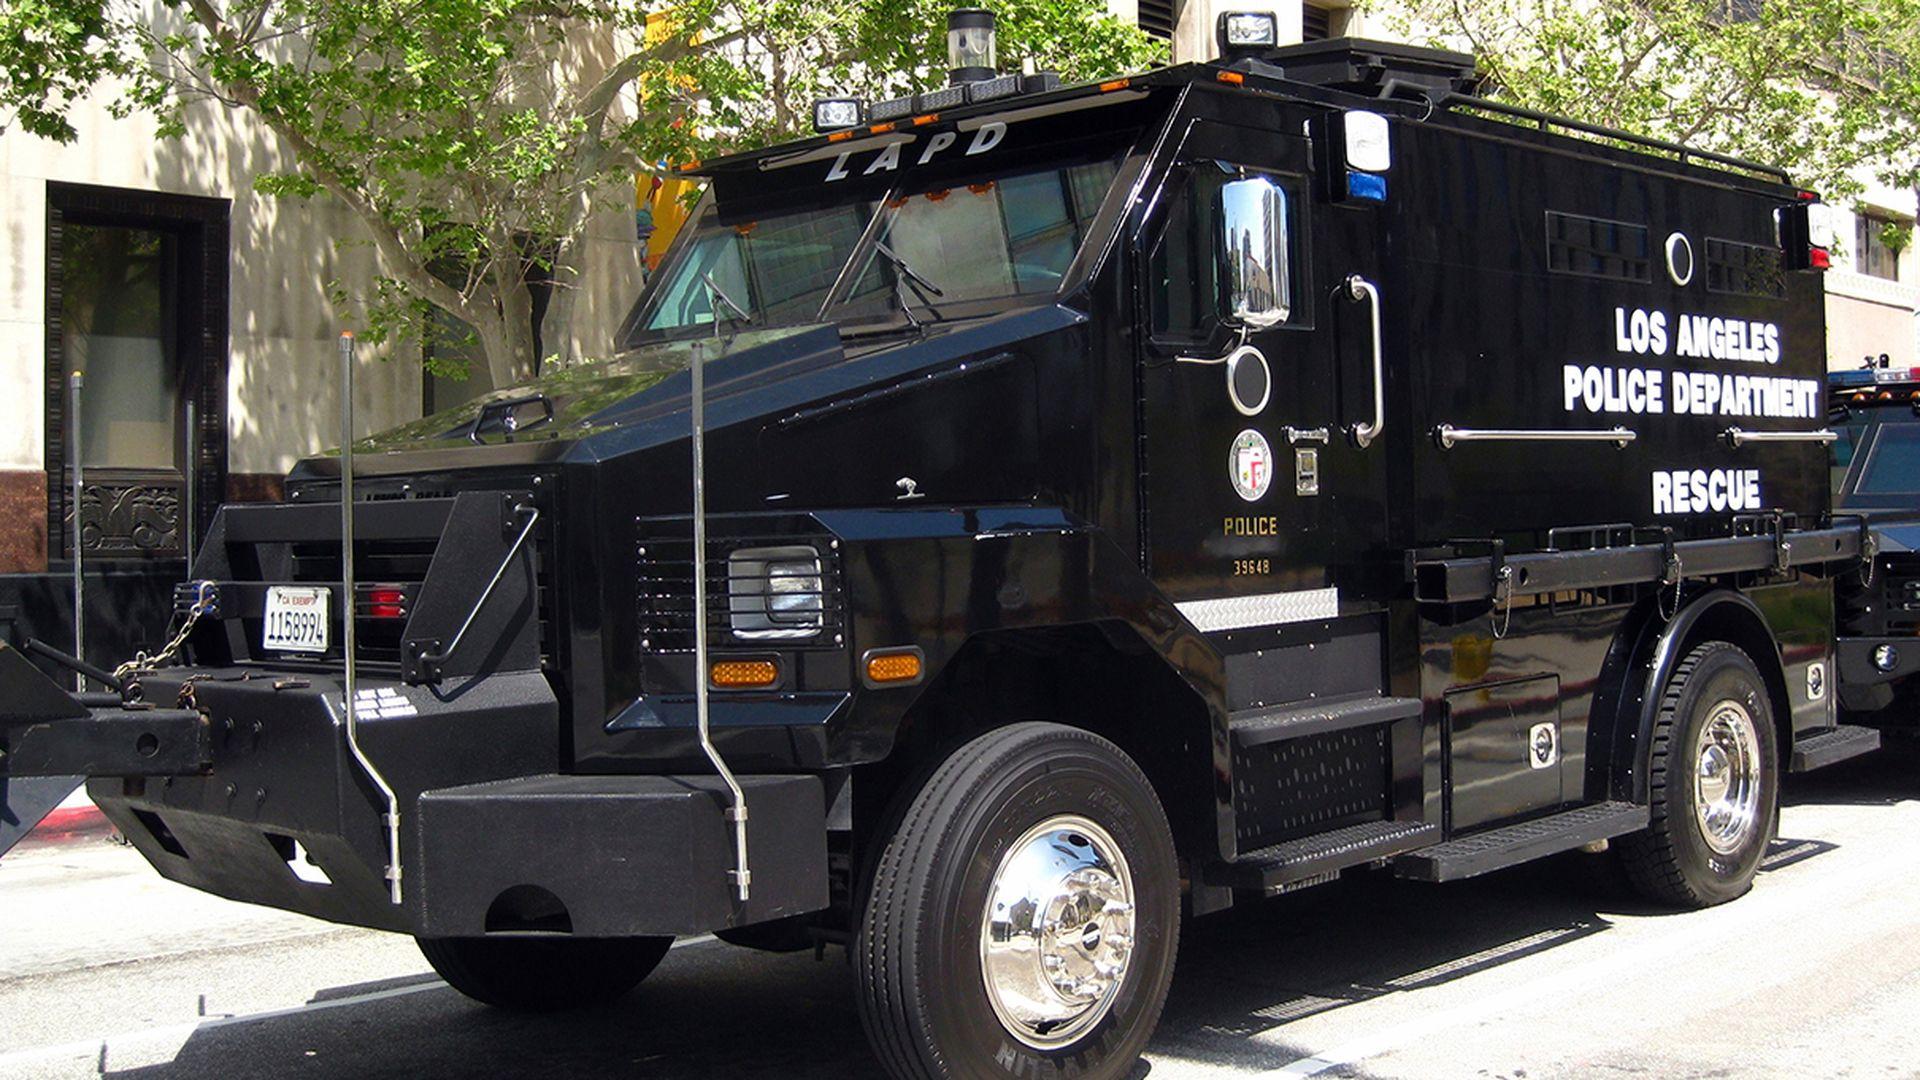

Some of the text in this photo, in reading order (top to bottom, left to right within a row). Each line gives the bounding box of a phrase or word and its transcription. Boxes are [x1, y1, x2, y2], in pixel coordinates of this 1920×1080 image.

[825, 122, 1008, 182] LAPD
[1614, 307, 1780, 364] LOS ANGELES
[1563, 365, 1819, 418] POLICE DEPARTMENT
[1652, 469, 1761, 514] RESCUE
[1224, 517, 1277, 536] POLICE
[1233, 559, 1270, 576] 39648
[268, 611, 323, 643] 1158994
